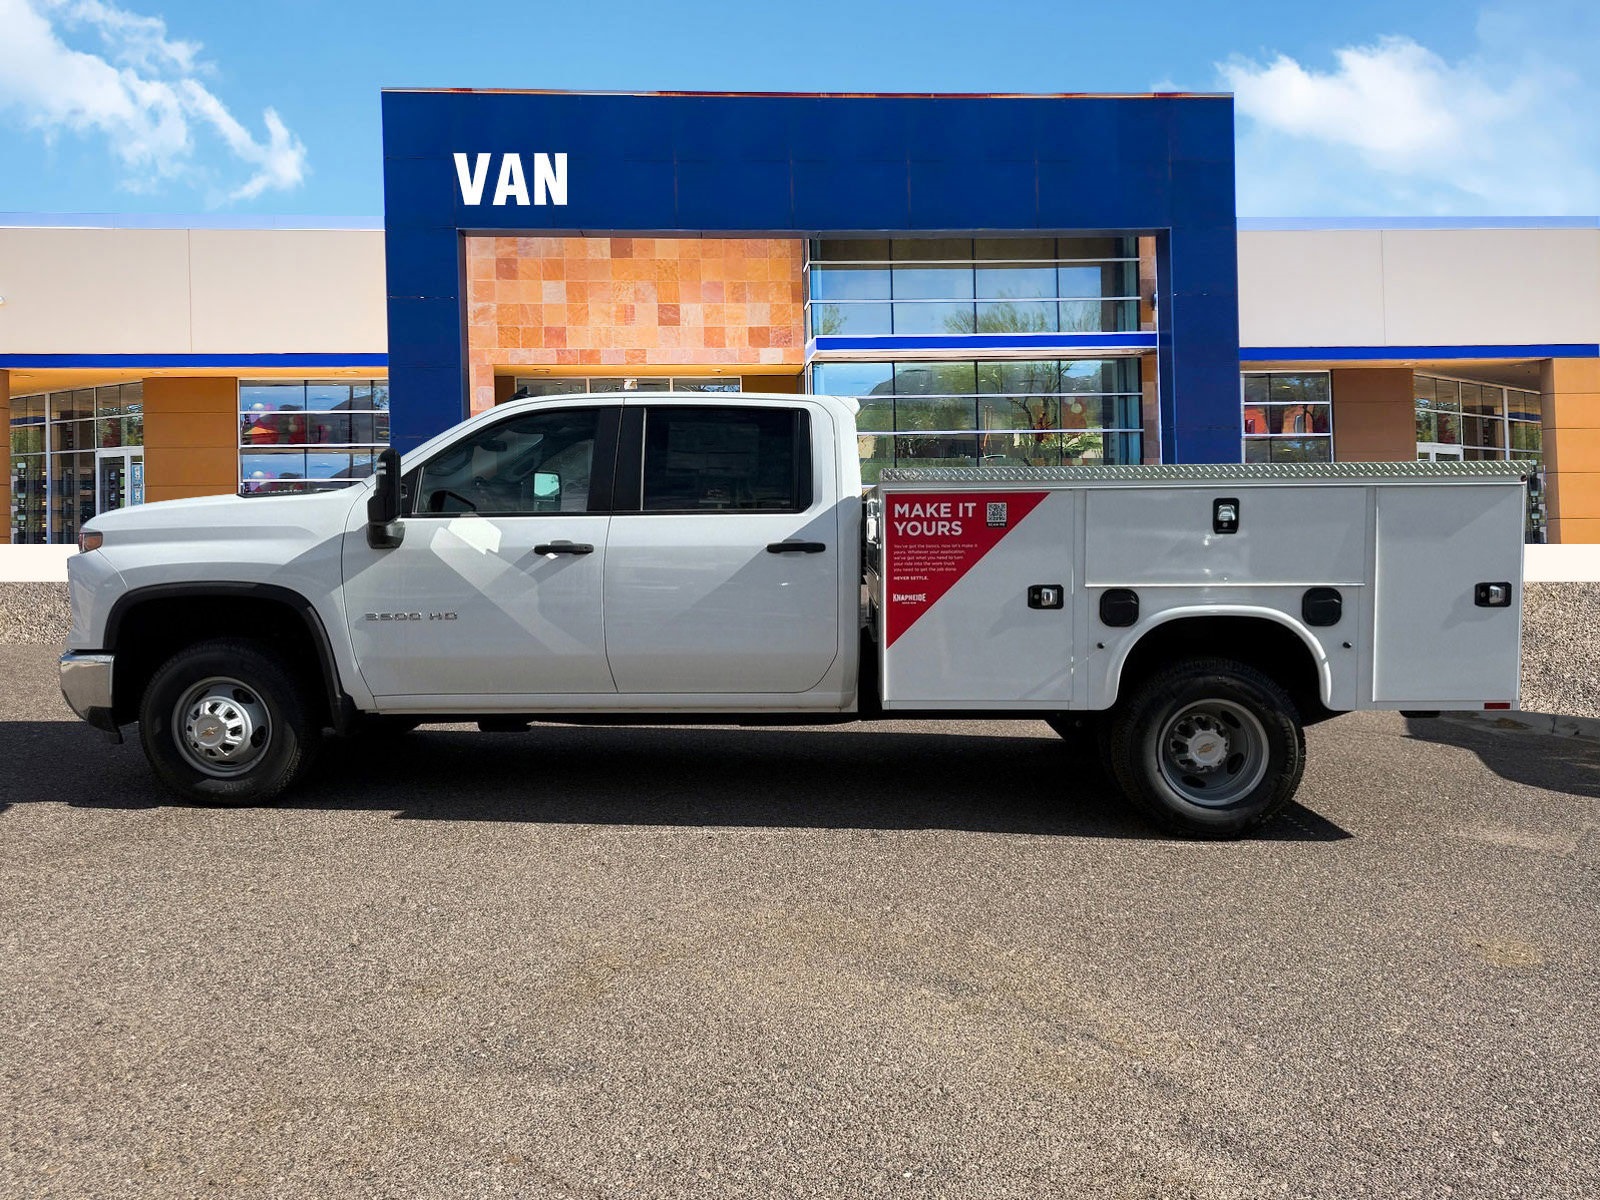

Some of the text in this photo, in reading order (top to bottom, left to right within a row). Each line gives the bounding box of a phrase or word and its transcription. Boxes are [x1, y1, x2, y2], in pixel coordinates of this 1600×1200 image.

[453, 153, 568, 206] VAN
[894, 503, 977, 518] MAKE IT
[894, 521, 962, 536] YOURS
[893, 593, 926, 602] KNAPHEIDE
